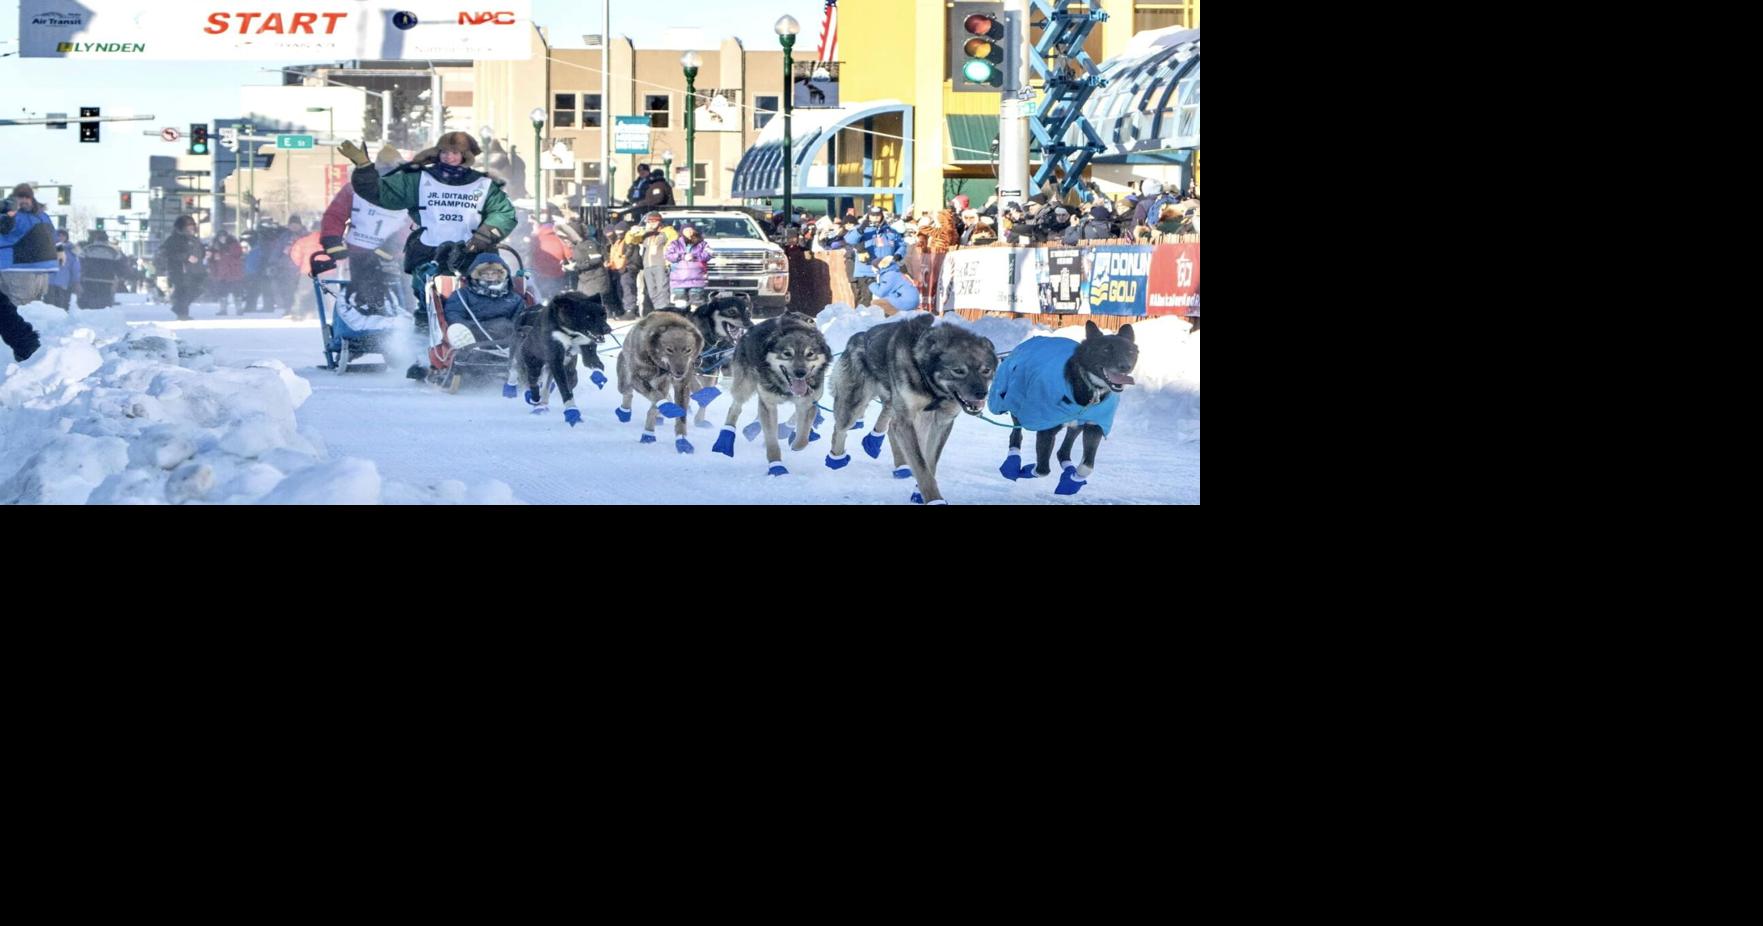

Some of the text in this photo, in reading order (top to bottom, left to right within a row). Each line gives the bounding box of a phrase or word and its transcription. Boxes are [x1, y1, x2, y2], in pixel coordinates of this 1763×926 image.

[203, 12, 348, 35] START
[458, 11, 515, 25] NAC
[74, 42, 146, 53] LYNDEN
[283, 137, 292, 147] E
[427, 191, 479, 202] JR. IDITAROD
[428, 200, 477, 209] CHAMPION
[439, 213, 464, 222] 2023
[374, 219, 384, 236] 1
[1110, 252, 1152, 276] DONLIN
[1109, 280, 1138, 302] GOLD
